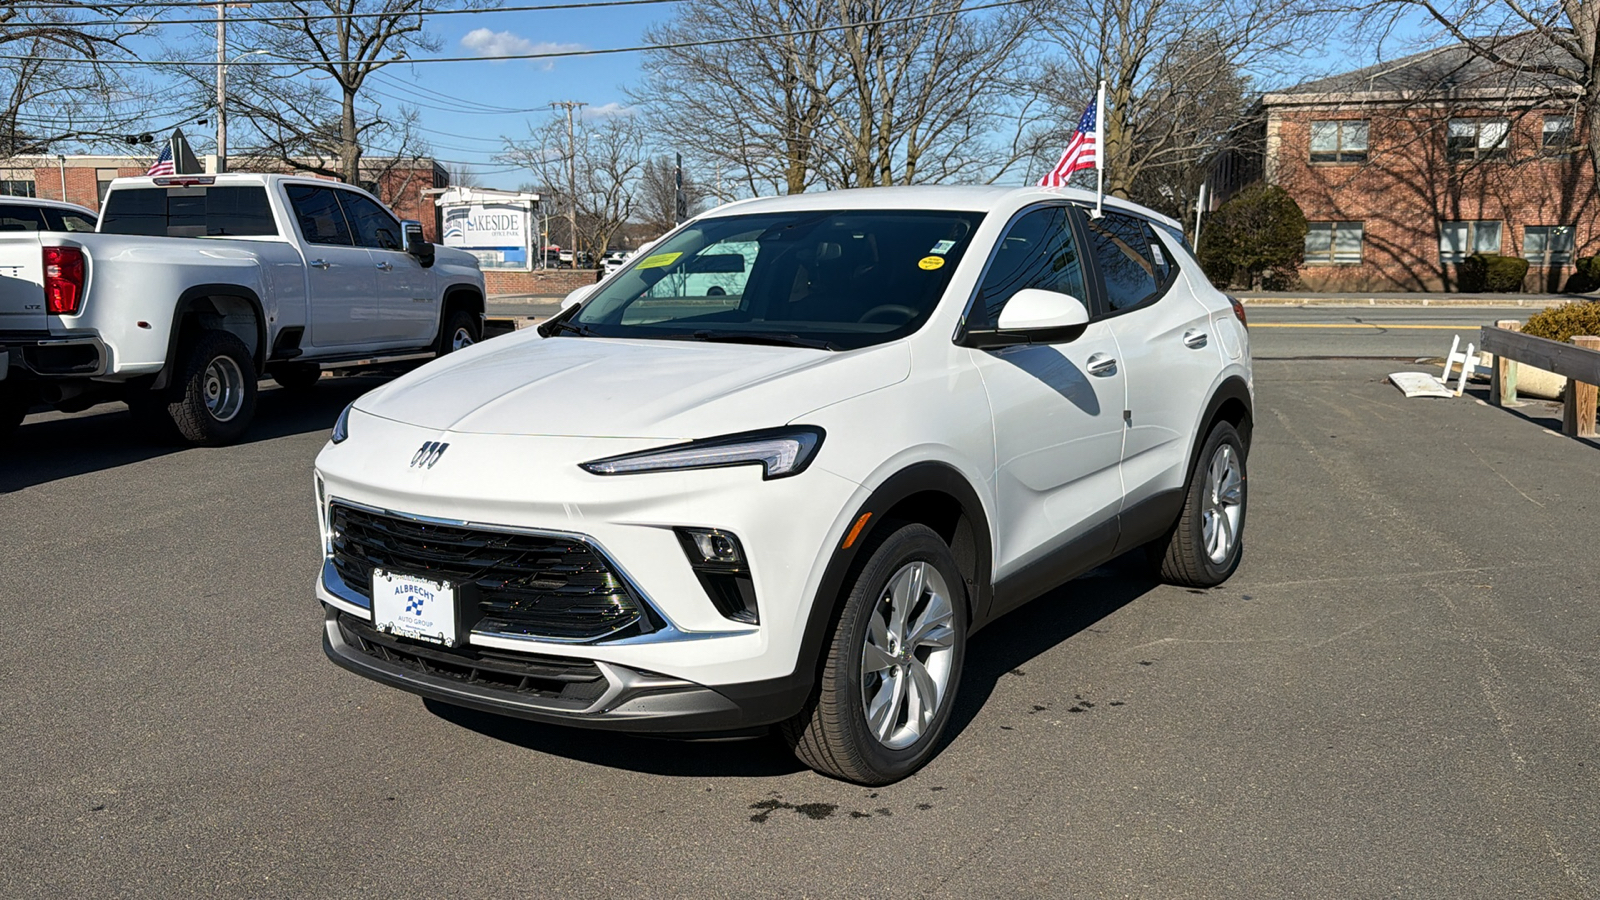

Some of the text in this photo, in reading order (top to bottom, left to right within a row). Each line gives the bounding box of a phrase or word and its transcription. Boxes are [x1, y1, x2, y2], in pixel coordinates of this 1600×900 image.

[467, 214, 519, 231] LAKESIDE
[394, 584, 435, 602] ALBRECHT
[398, 615, 413, 624] AUTO
[413, 618, 434, 628] GROUP
